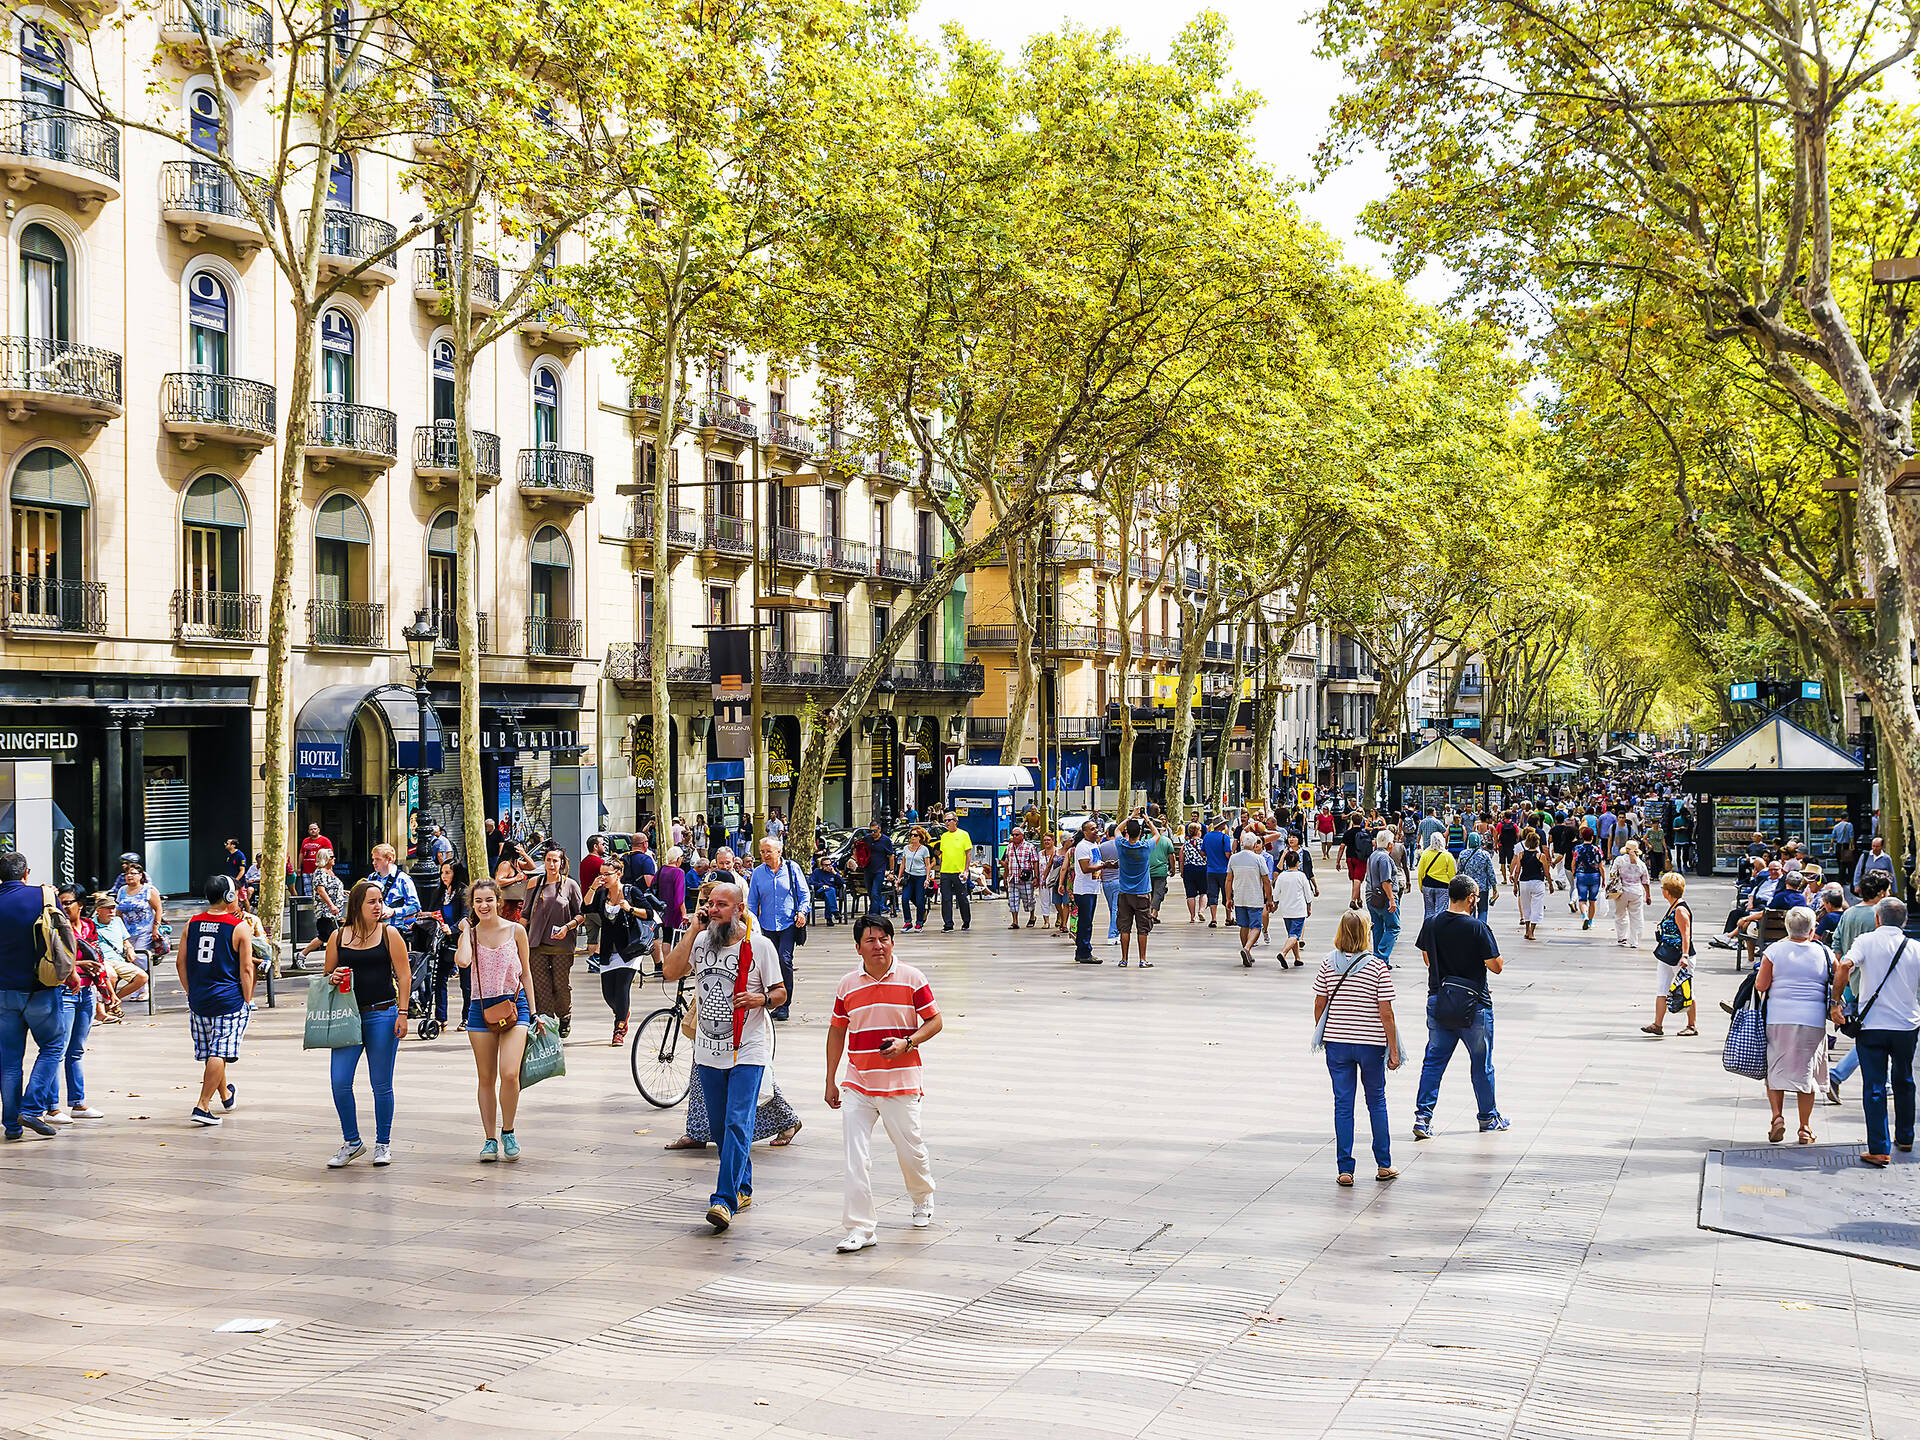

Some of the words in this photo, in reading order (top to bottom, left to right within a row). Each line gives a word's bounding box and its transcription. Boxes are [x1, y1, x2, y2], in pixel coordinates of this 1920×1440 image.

[191, 274, 221, 300] O
[322, 310, 348, 335] T
[433, 341, 454, 363] E
[533, 369, 554, 391] L
[451, 731, 506, 748] CUB
[300, 750, 339, 765] HOTEL
[200, 922, 220, 933] GEORGE
[198, 936, 215, 963] 8
